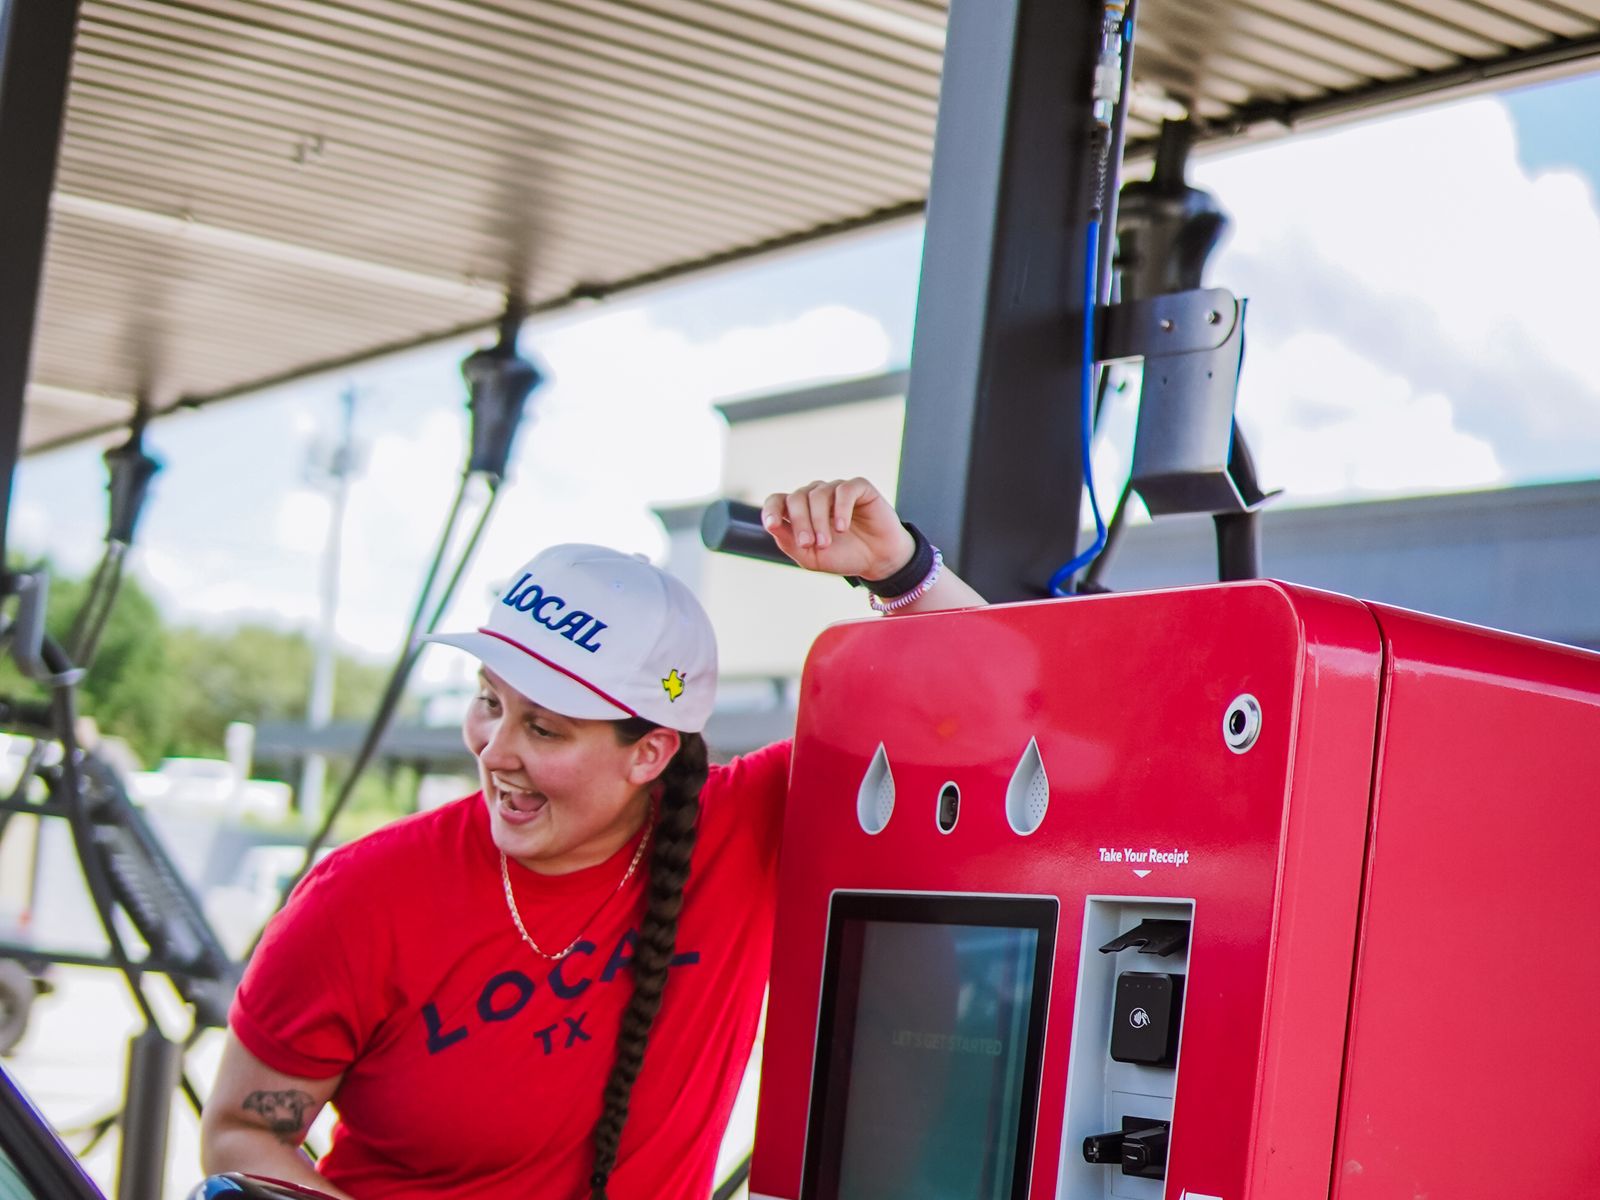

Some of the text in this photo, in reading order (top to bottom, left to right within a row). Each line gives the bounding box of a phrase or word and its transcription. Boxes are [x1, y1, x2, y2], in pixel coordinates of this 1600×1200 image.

[502, 572, 608, 653] LOCAL
[1099, 848, 1189, 867] Take Your Receipt
[533, 1011, 592, 1055] TX
